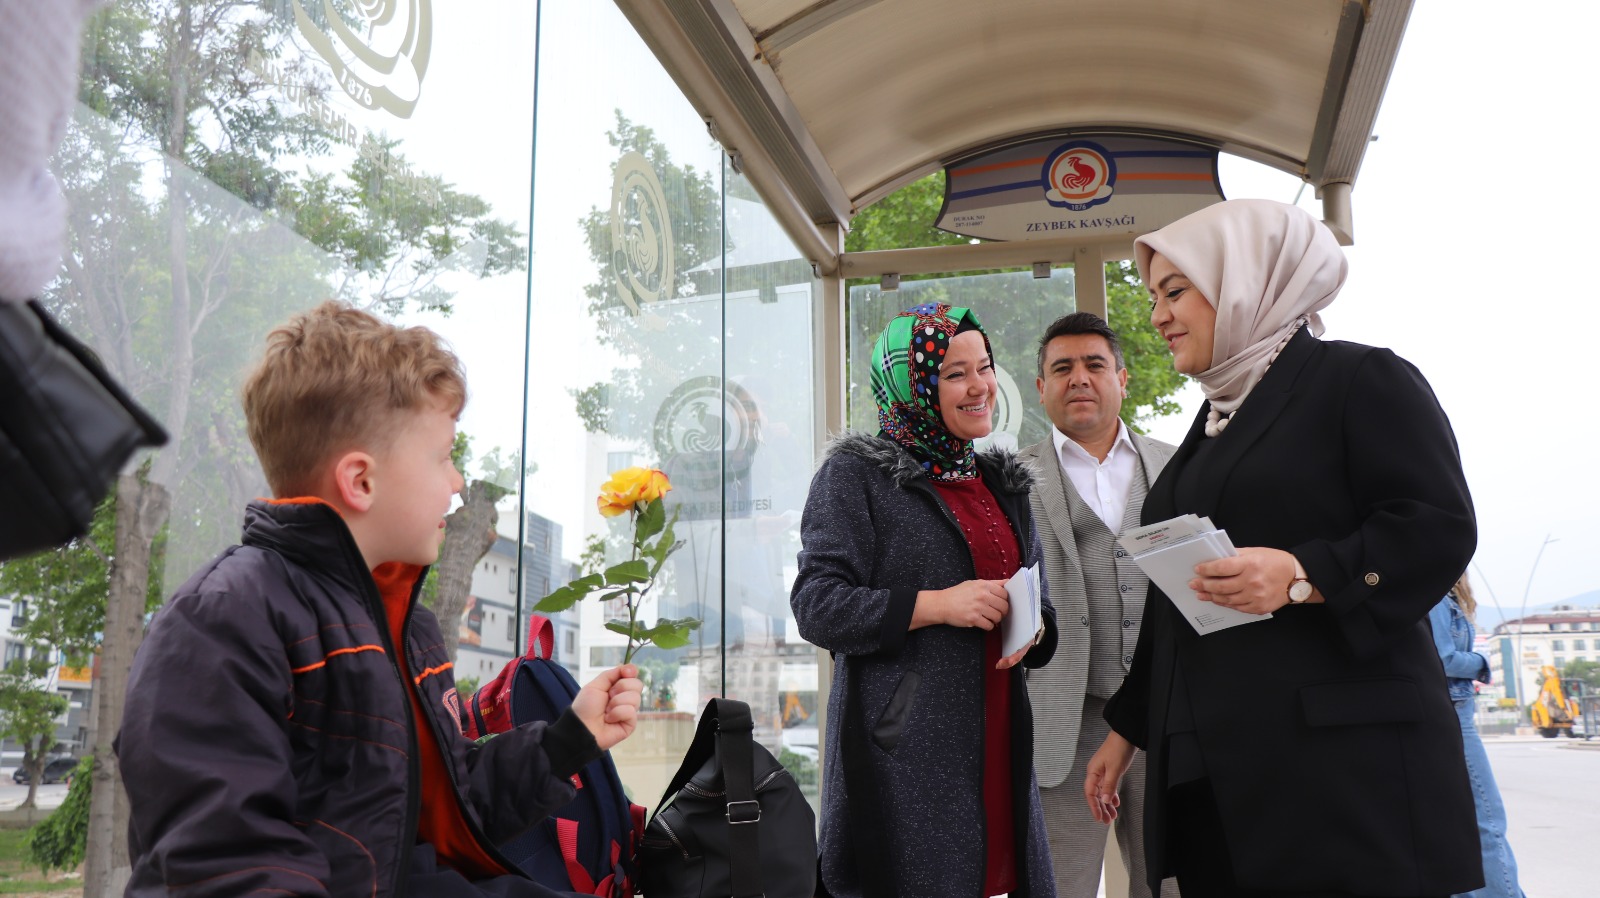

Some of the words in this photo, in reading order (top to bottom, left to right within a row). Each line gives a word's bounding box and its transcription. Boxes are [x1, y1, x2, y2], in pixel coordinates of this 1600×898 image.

[340, 67, 374, 106] 1876
[1026, 219, 1077, 233] ZEYBEK
[1080, 214, 1136, 229] KAVŞAĞI
